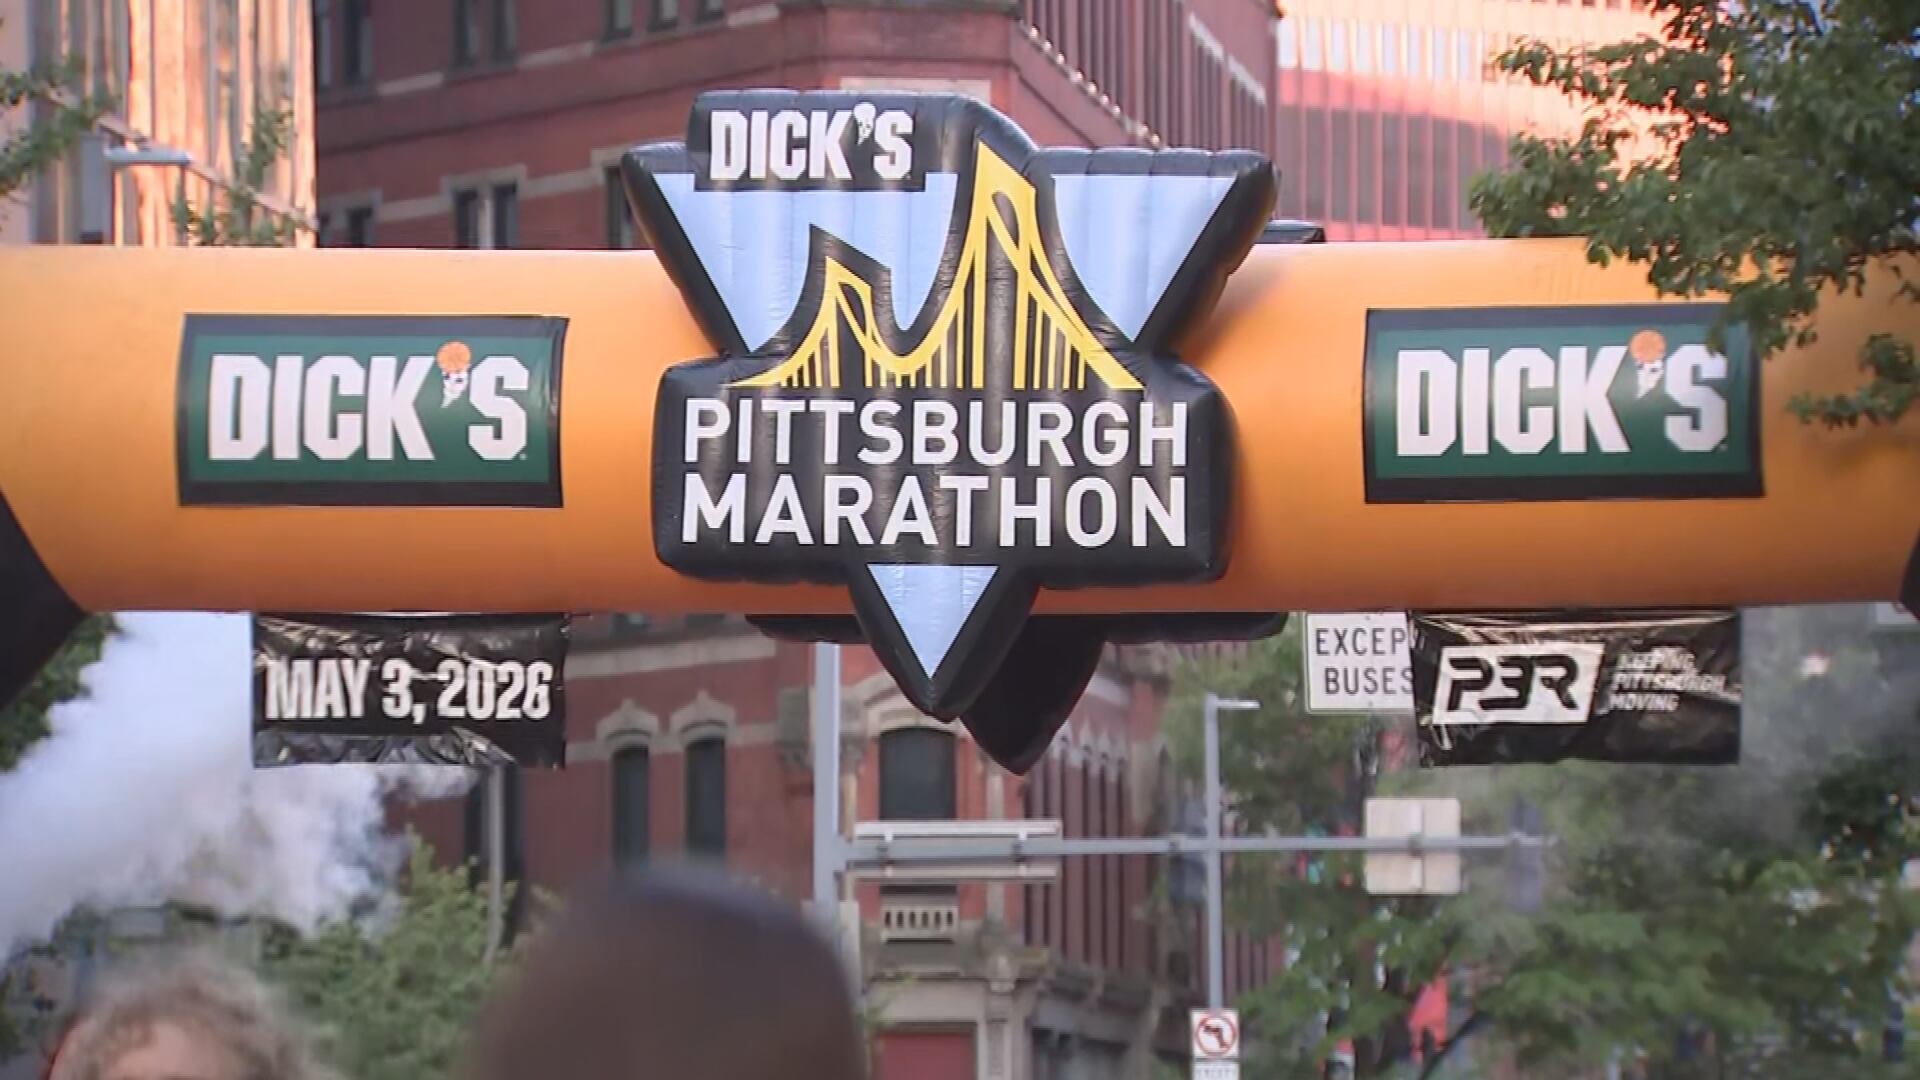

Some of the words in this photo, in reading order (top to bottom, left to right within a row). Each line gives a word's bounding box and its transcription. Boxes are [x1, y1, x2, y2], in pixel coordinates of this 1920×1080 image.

[709, 101, 914, 181] DICK'S
[208, 341, 530, 461] DICK'S
[1397, 329, 1729, 457] DICK'S
[682, 397, 1189, 468] PITTSBURGH
[680, 472, 1189, 549] MARATHON
[1315, 627, 1407, 656] EXCEP
[264, 658, 371, 720] MAY
[382, 657, 427, 725] 3,
[437, 658, 553, 720] 2026
[1324, 665, 1414, 696] BUSES
[1608, 692, 1680, 712] MOVING
